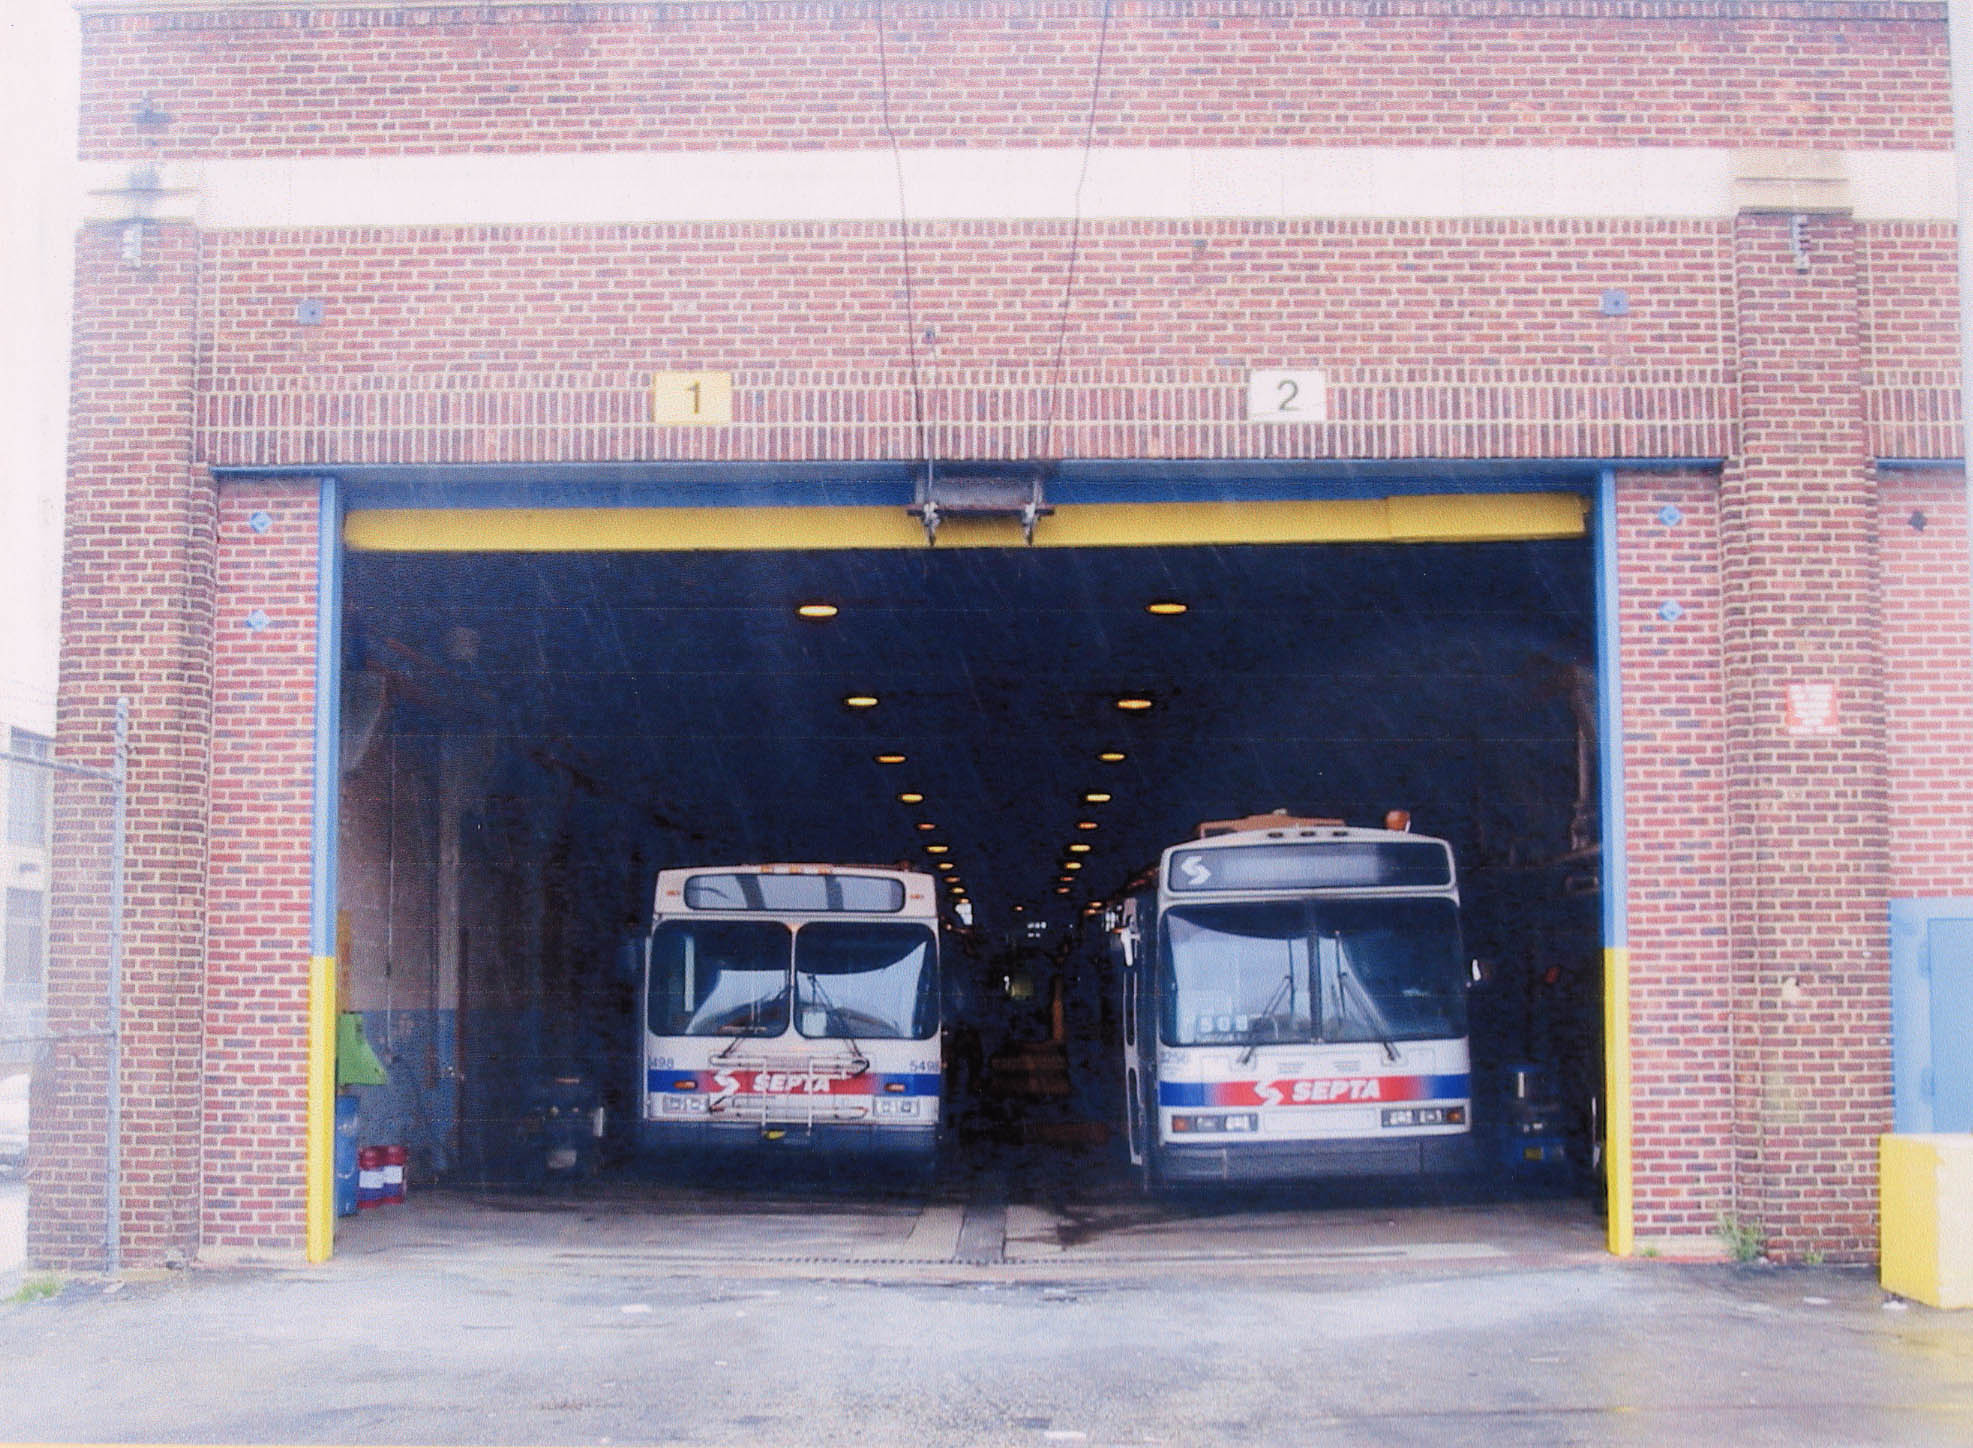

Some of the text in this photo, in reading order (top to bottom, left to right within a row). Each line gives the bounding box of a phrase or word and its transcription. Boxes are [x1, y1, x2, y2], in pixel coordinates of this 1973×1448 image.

[683, 381, 700, 414] 1
[1278, 379, 1303, 411] 2
[753, 1073, 831, 1092] SEPTA
[1292, 1079, 1381, 1102] SEPTA
